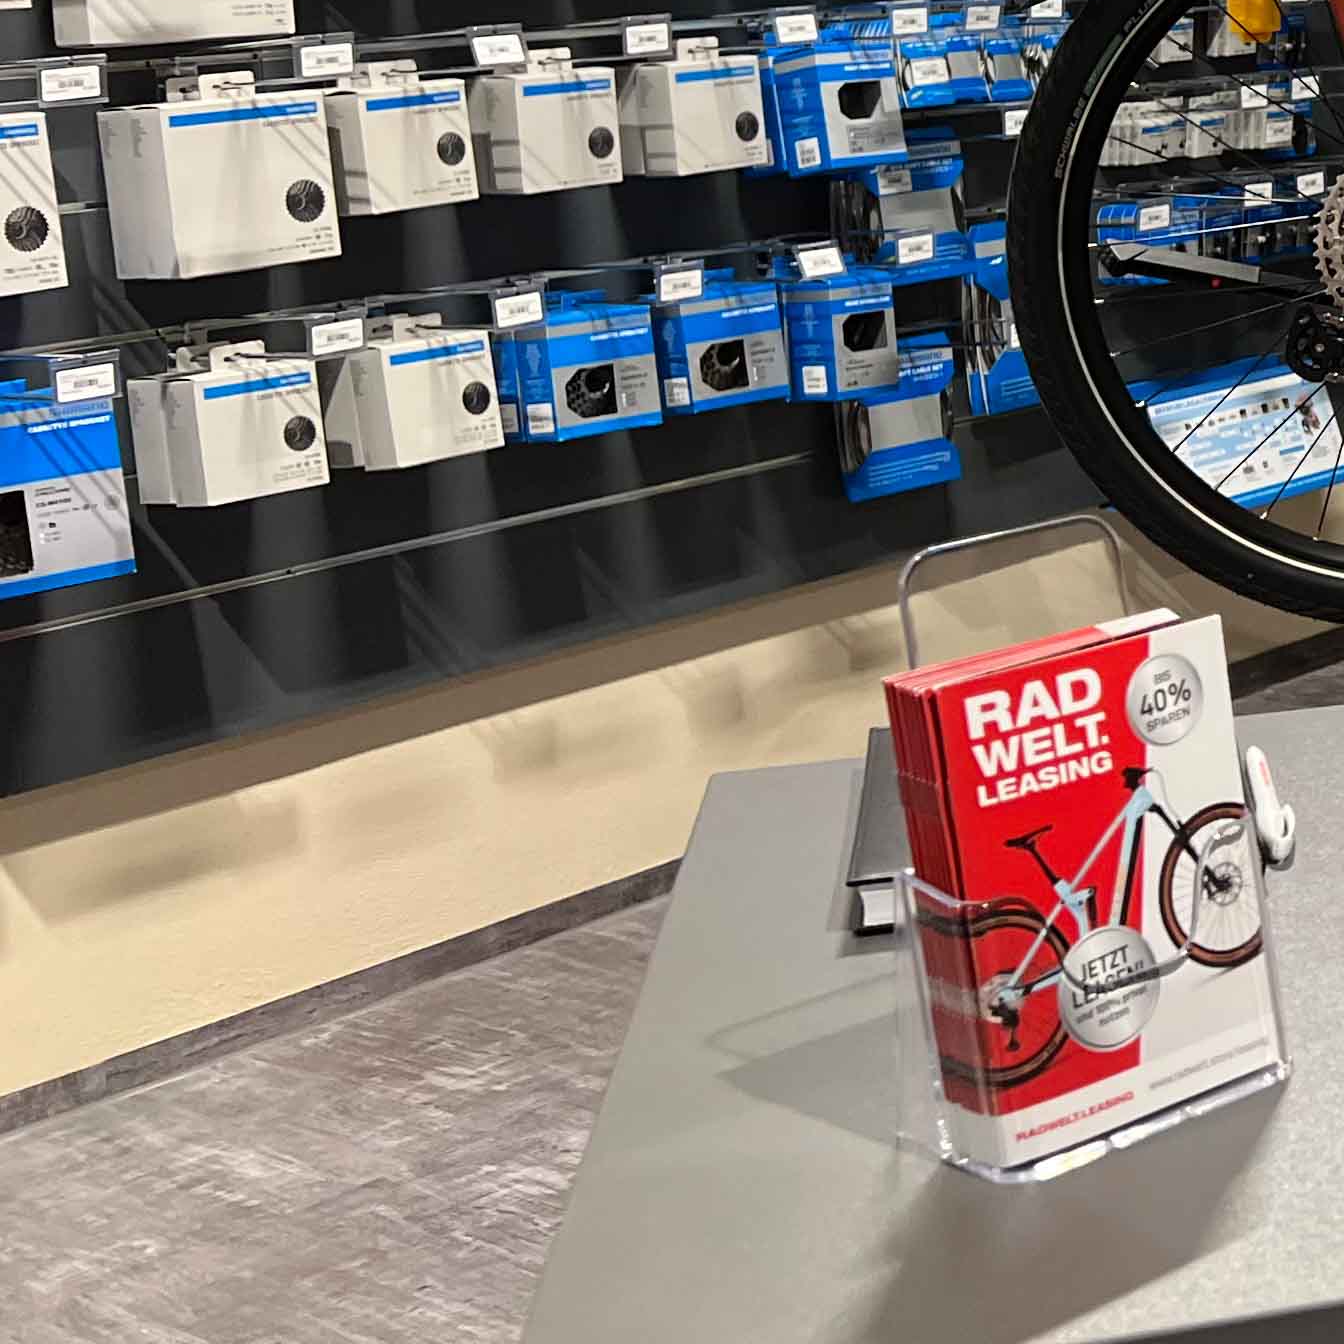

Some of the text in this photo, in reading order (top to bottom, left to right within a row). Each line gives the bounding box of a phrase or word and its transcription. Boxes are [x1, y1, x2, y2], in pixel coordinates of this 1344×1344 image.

[1153, 670, 1172, 686] BIS
[964, 667, 1102, 741] RAD
[1140, 679, 1192, 717] 40%
[1146, 708, 1192, 733] SPAREN
[972, 711, 1109, 778] WELT.
[976, 750, 1114, 808] LEASING
[1081, 944, 1128, 983] JETZT
